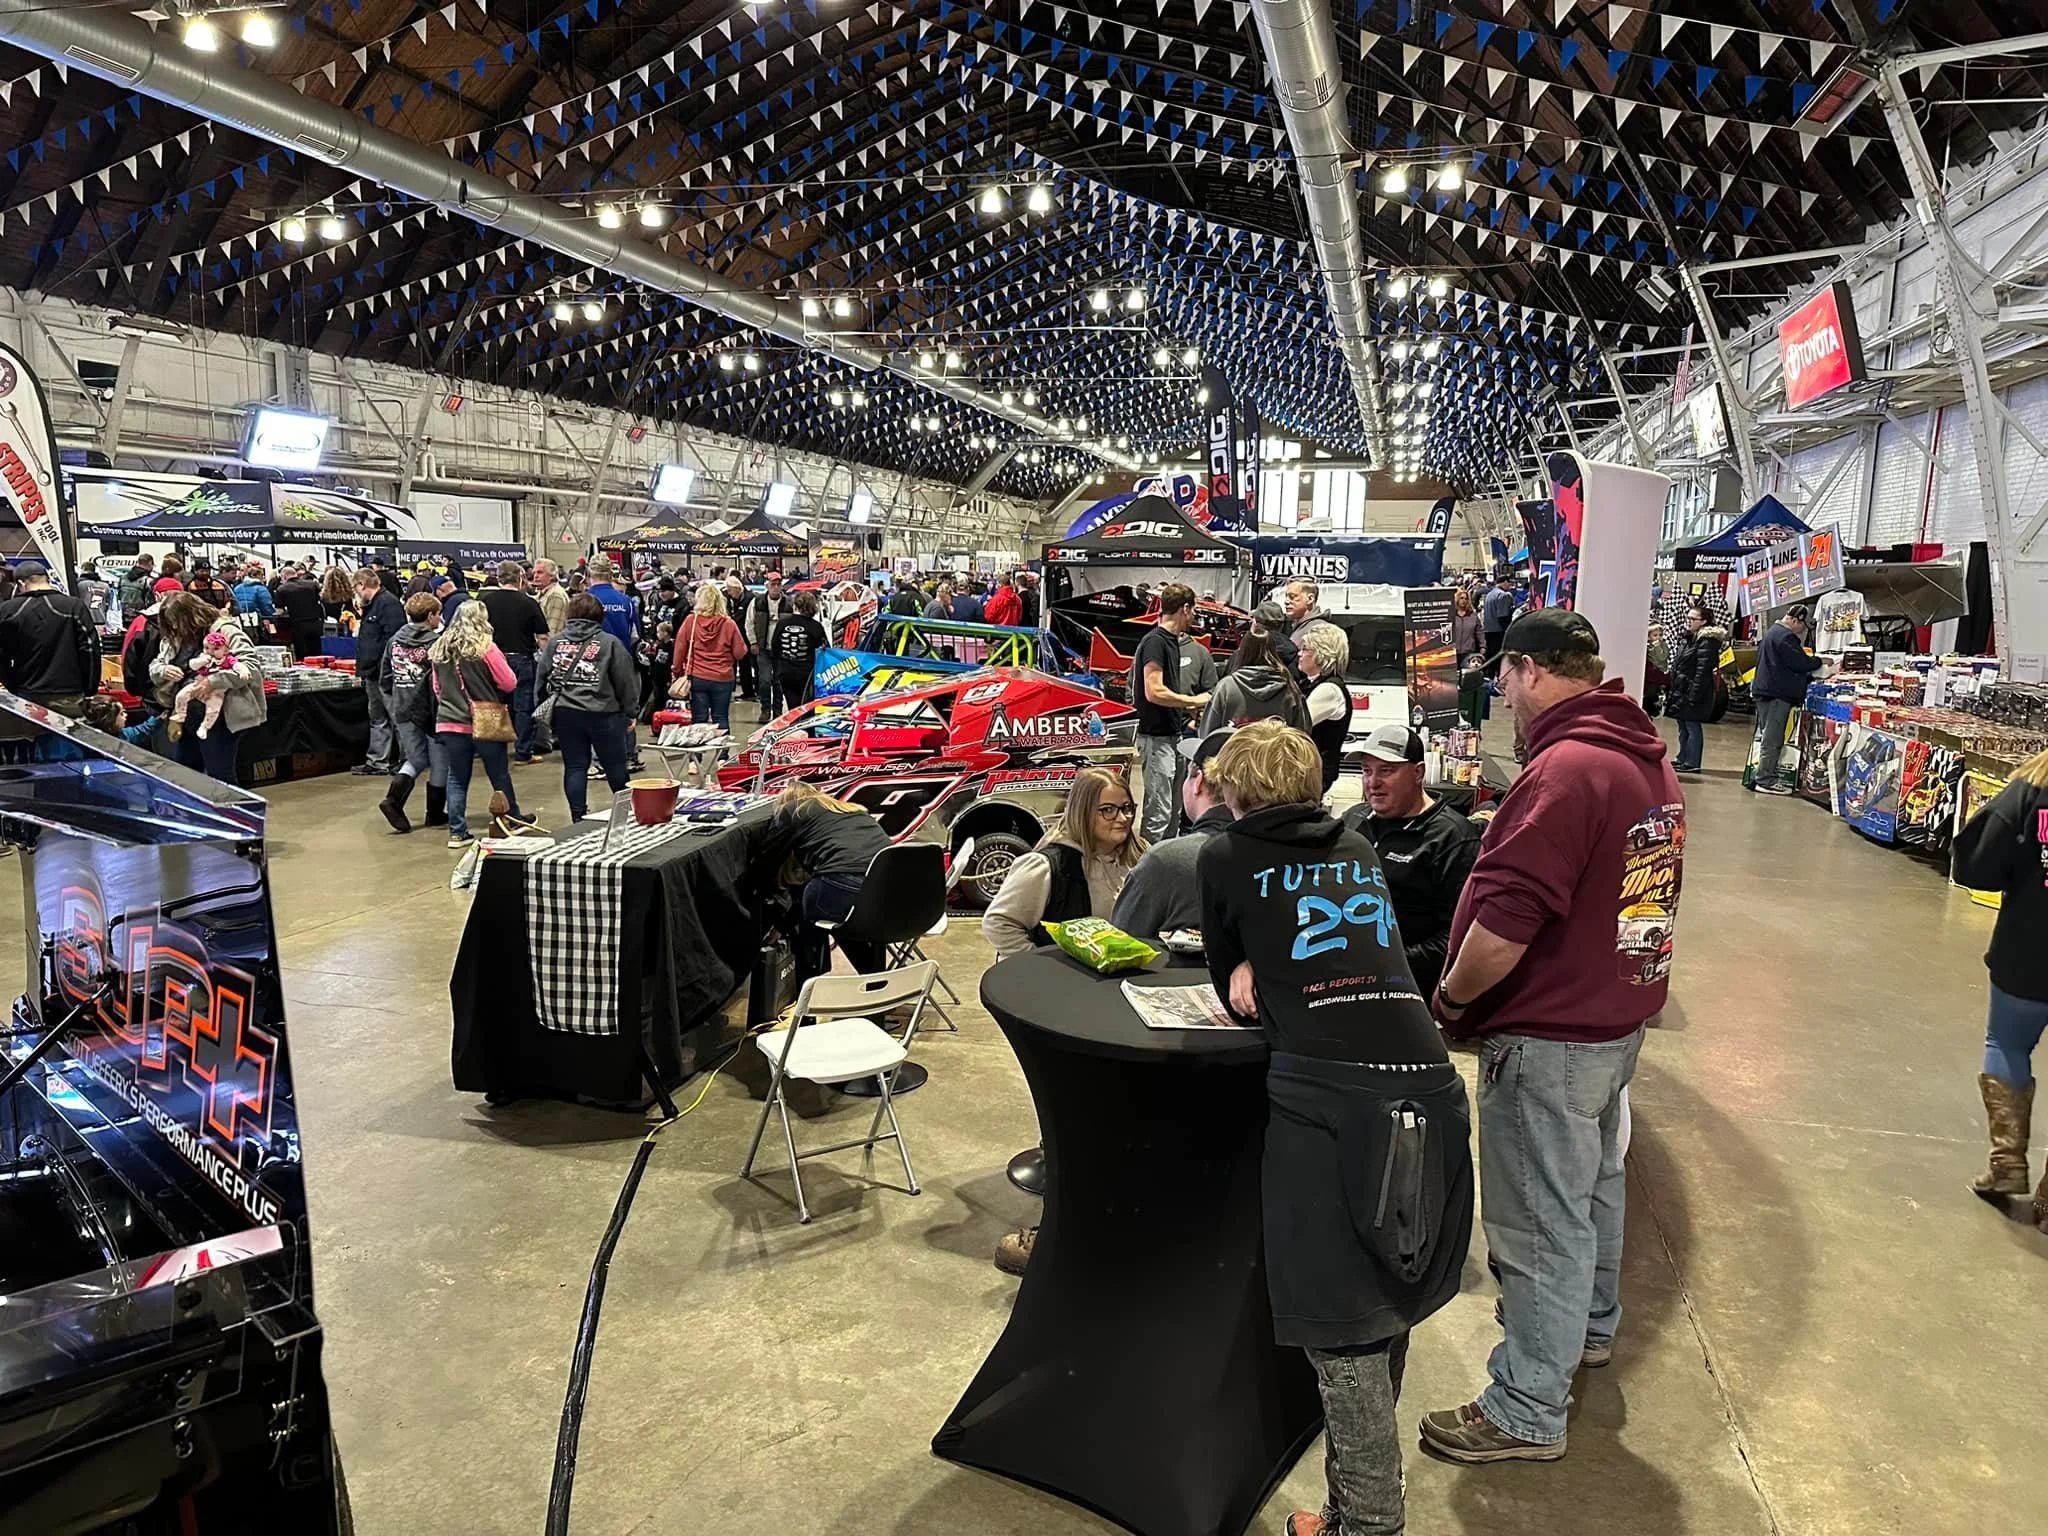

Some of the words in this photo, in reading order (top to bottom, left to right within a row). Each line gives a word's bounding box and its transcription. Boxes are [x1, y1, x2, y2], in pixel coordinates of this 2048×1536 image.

[1798, 325, 1840, 368] TOYOTA
[0, 442, 46, 524] STRIPES
[41, 519, 61, 546] TOOL
[1738, 539, 1768, 547] HALL
[648, 542, 687, 550] WINERY
[739, 545, 780, 553] WINERY
[101, 559, 139, 567] TORQU
[1261, 555, 1348, 580] VINNIES
[822, 655, 860, 684] AROUND
[989, 714, 1084, 738] AMBER
[1020, 736, 1058, 747] WATER
[1253, 860, 1386, 898] TUTTLE
[1619, 866, 1675, 900] Moo
[63, 1032, 90, 1071] SCOTT
[138, 1093, 233, 1195] PERFORMANCE
[232, 1179, 278, 1226] PLUS
